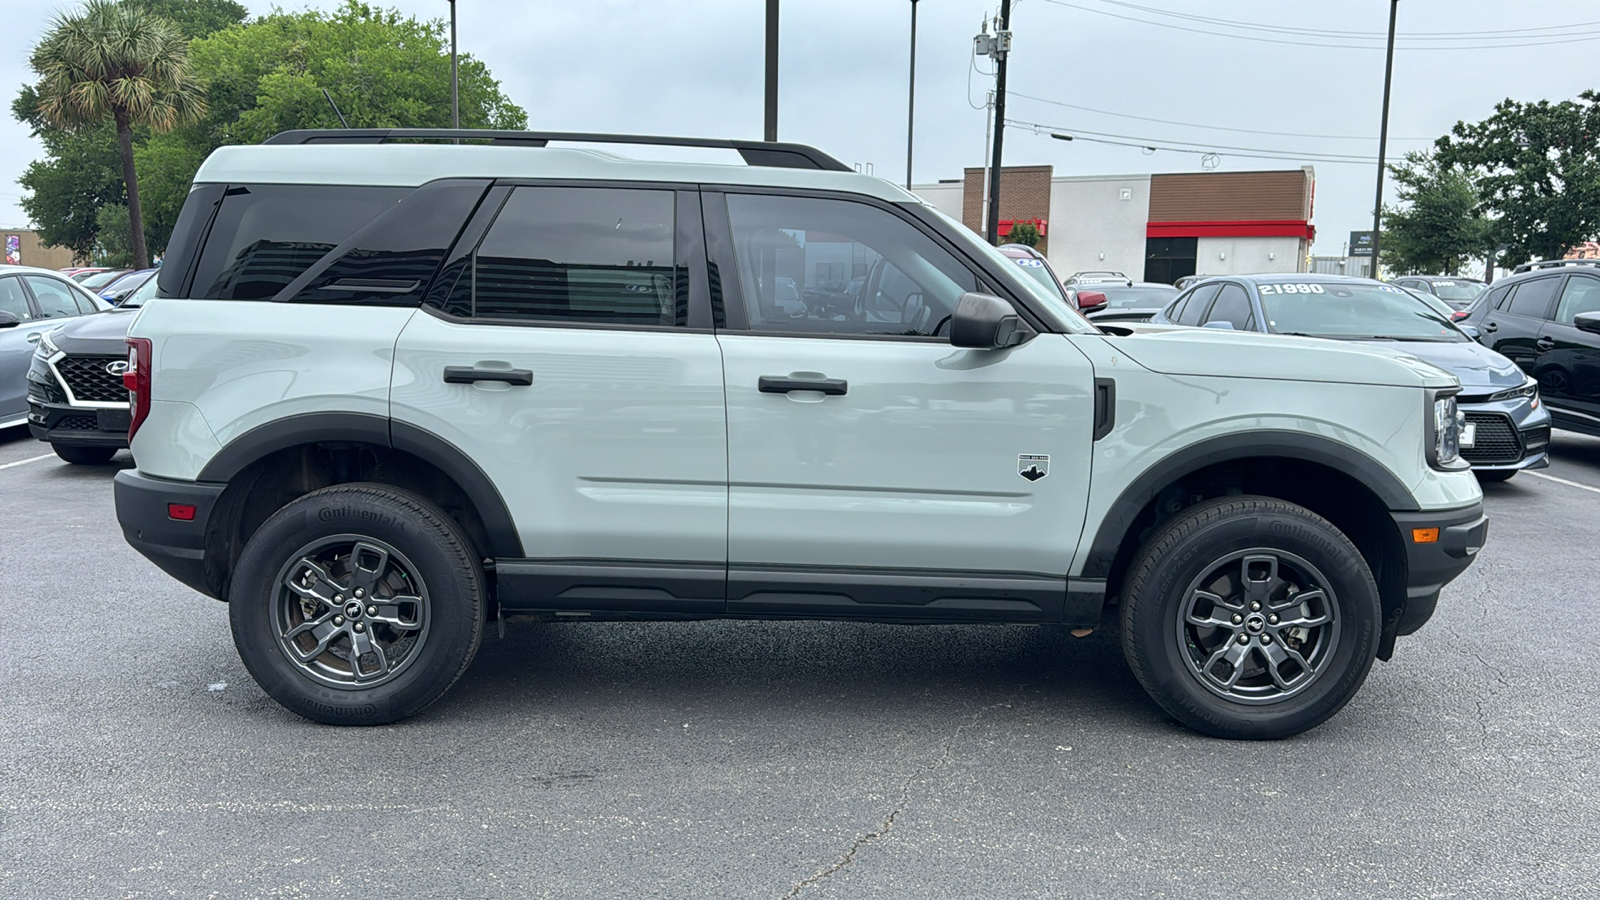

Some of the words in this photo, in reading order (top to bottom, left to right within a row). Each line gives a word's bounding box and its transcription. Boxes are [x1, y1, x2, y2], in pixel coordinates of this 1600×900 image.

[1258, 284, 1325, 295] 21990
[318, 505, 397, 528] Continental
[1269, 520, 1342, 557] Continental
